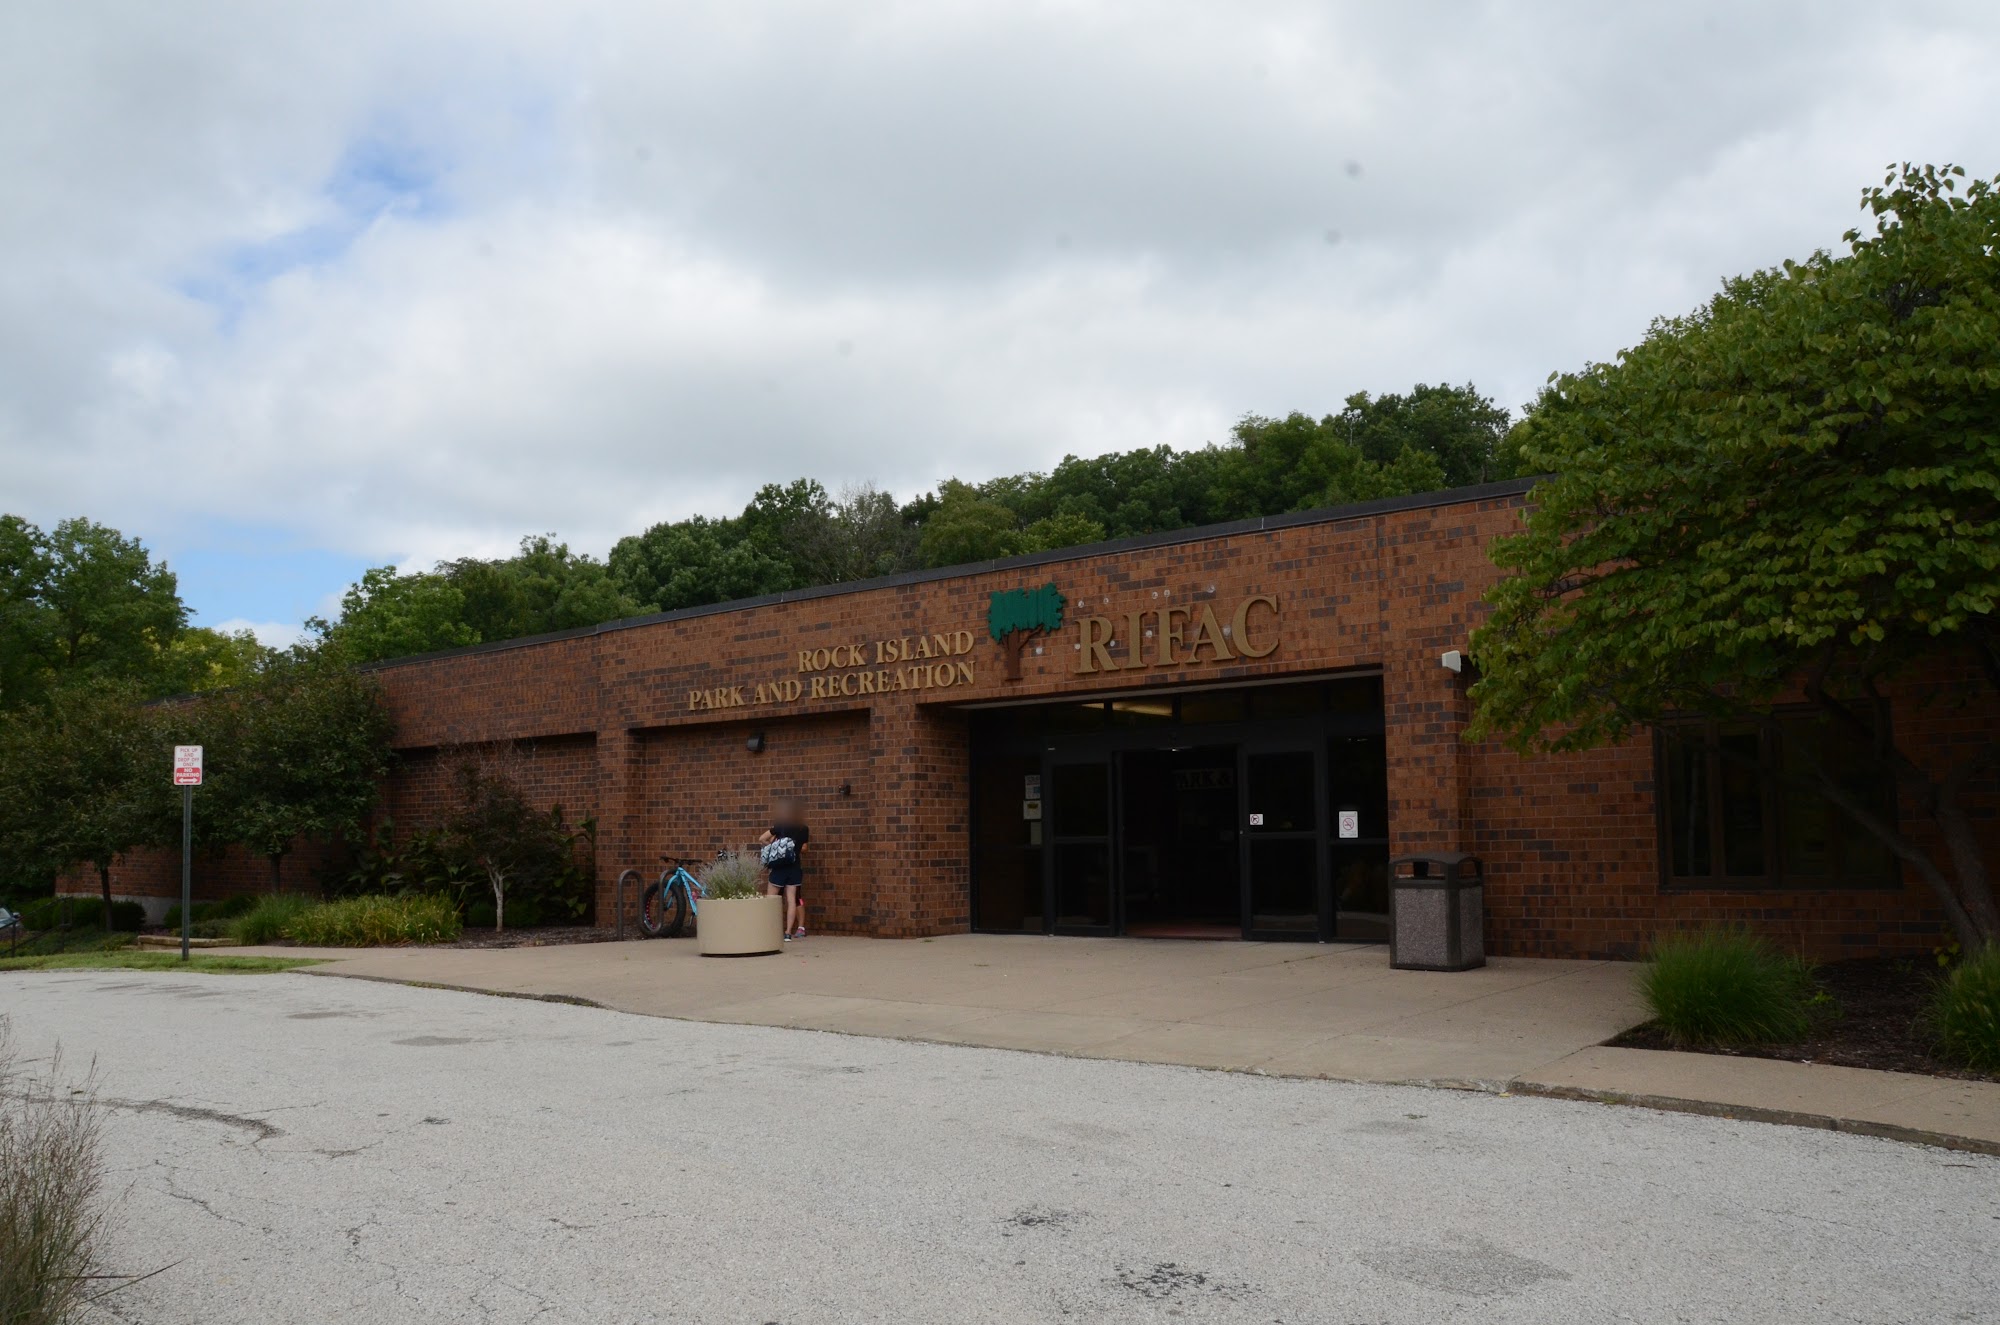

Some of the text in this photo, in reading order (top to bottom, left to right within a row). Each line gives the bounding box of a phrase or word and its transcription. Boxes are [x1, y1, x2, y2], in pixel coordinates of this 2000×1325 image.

[797, 630, 976, 673] ROCK ISLAND
[1074, 594, 1280, 675] RIFAC
[688, 661, 976, 711] PARK AND RECREATION
